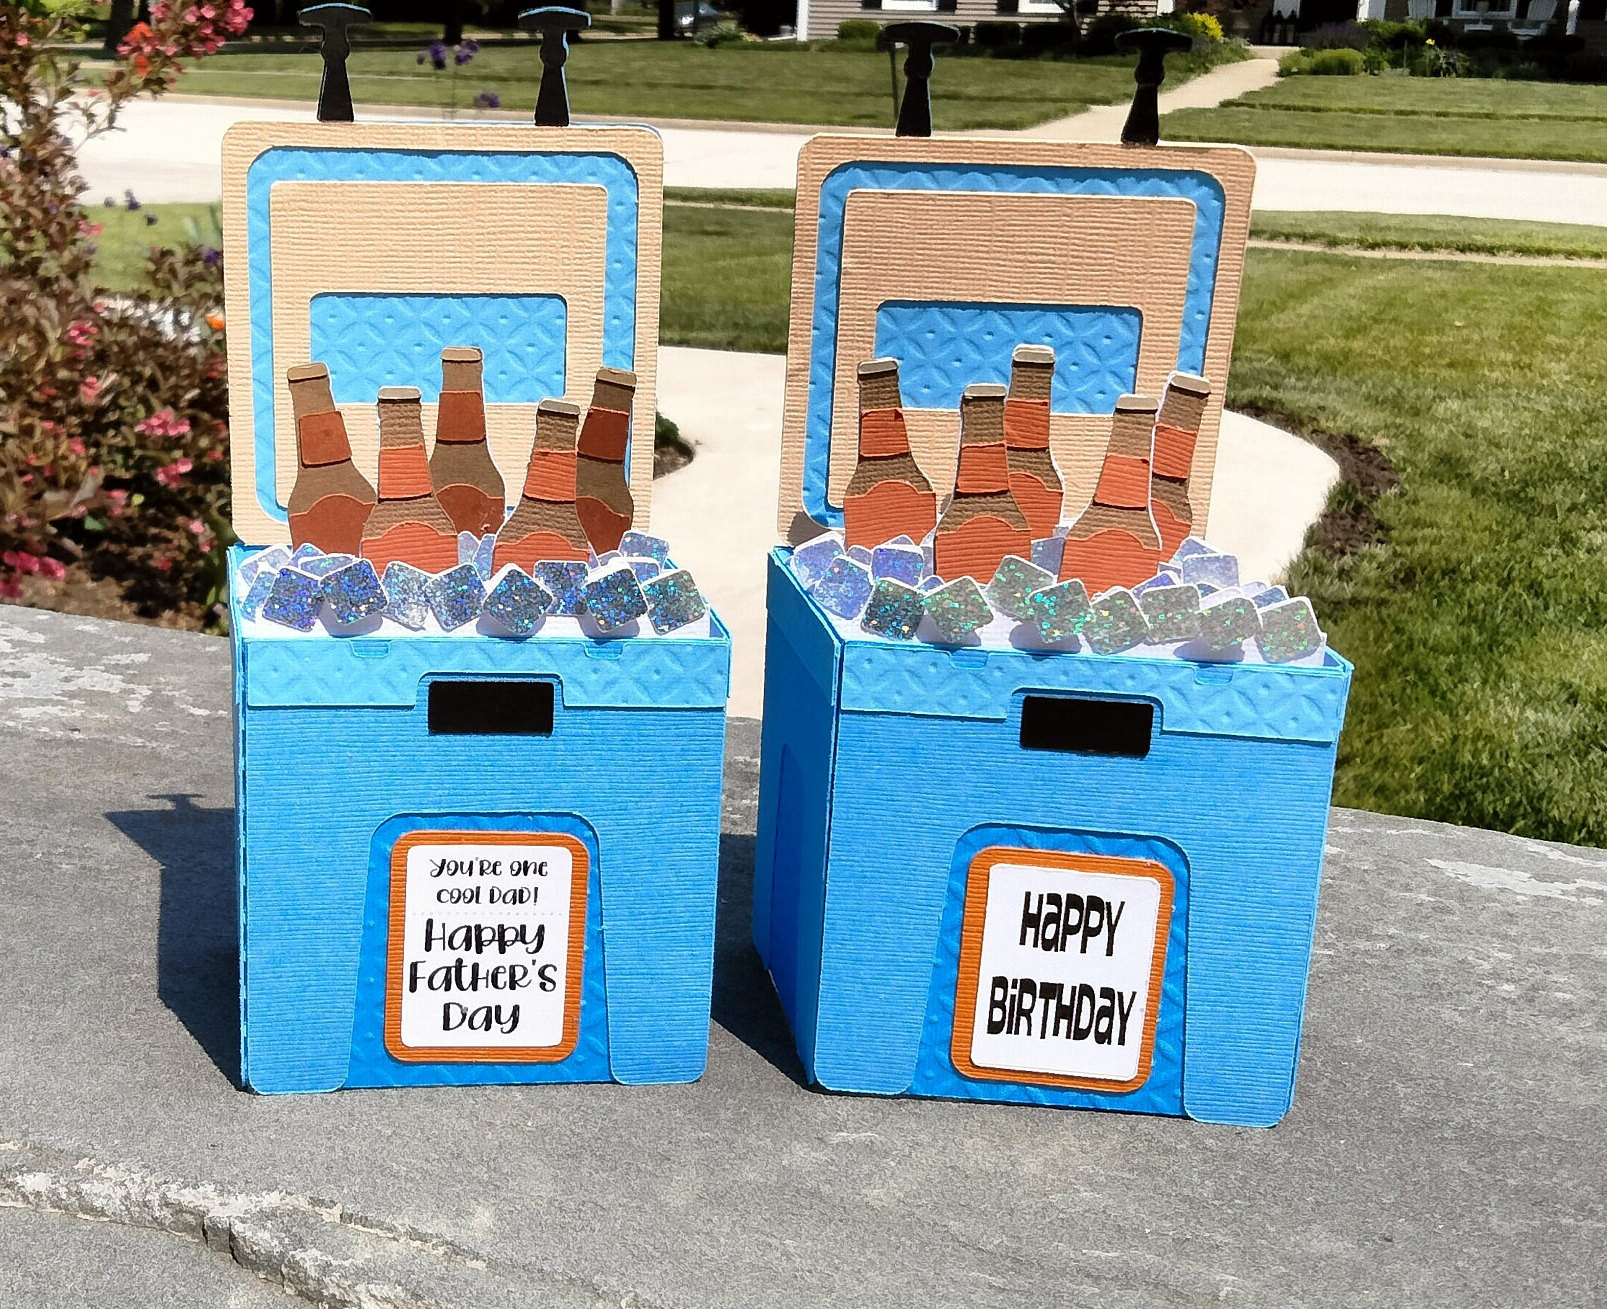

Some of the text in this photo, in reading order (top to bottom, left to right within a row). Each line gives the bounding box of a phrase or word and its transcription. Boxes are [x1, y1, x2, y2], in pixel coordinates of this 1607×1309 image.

[510, 859, 548, 877] one
[436, 886, 482, 905] cool
[424, 918, 546, 955] Happy
[442, 1002, 520, 1034] Day
